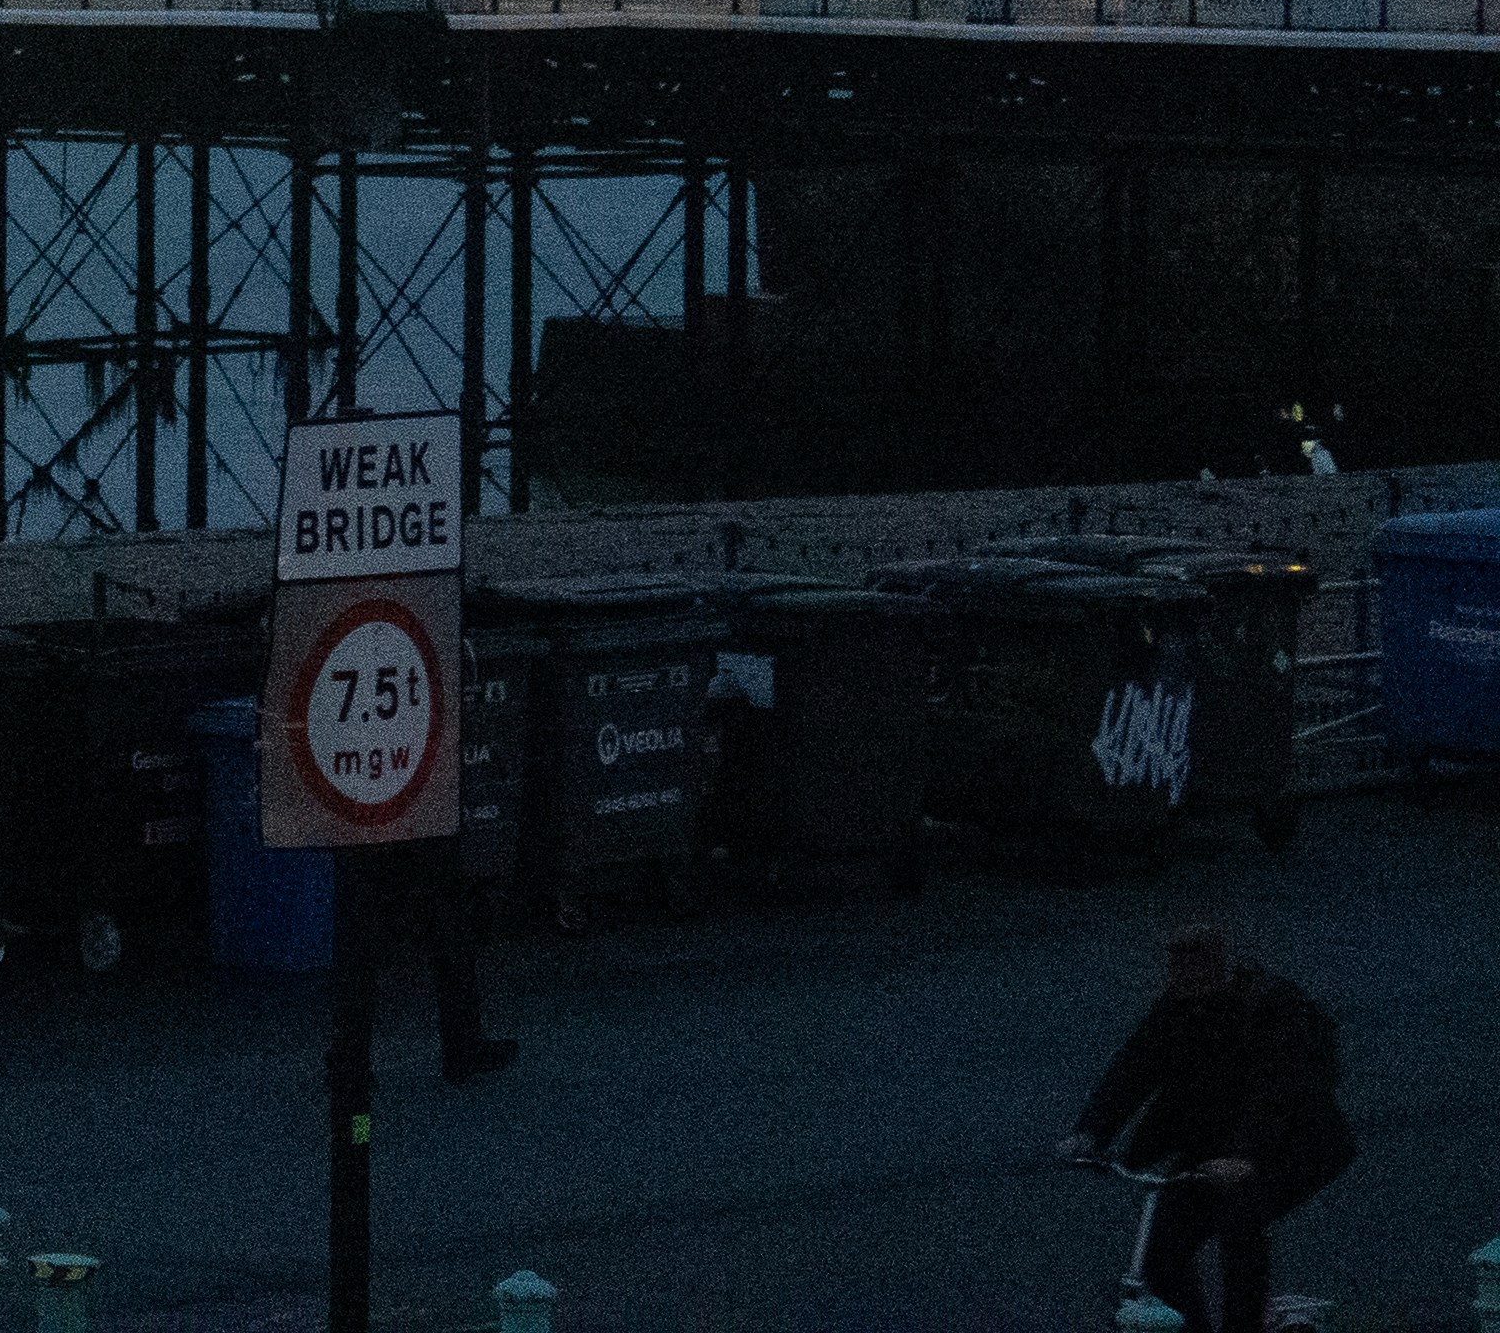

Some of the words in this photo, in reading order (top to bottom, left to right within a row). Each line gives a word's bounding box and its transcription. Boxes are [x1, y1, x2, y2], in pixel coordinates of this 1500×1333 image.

[319, 440, 431, 492] WEAK
[294, 501, 449, 555] BRIDGE
[621, 727, 684, 755] VEOLIA
